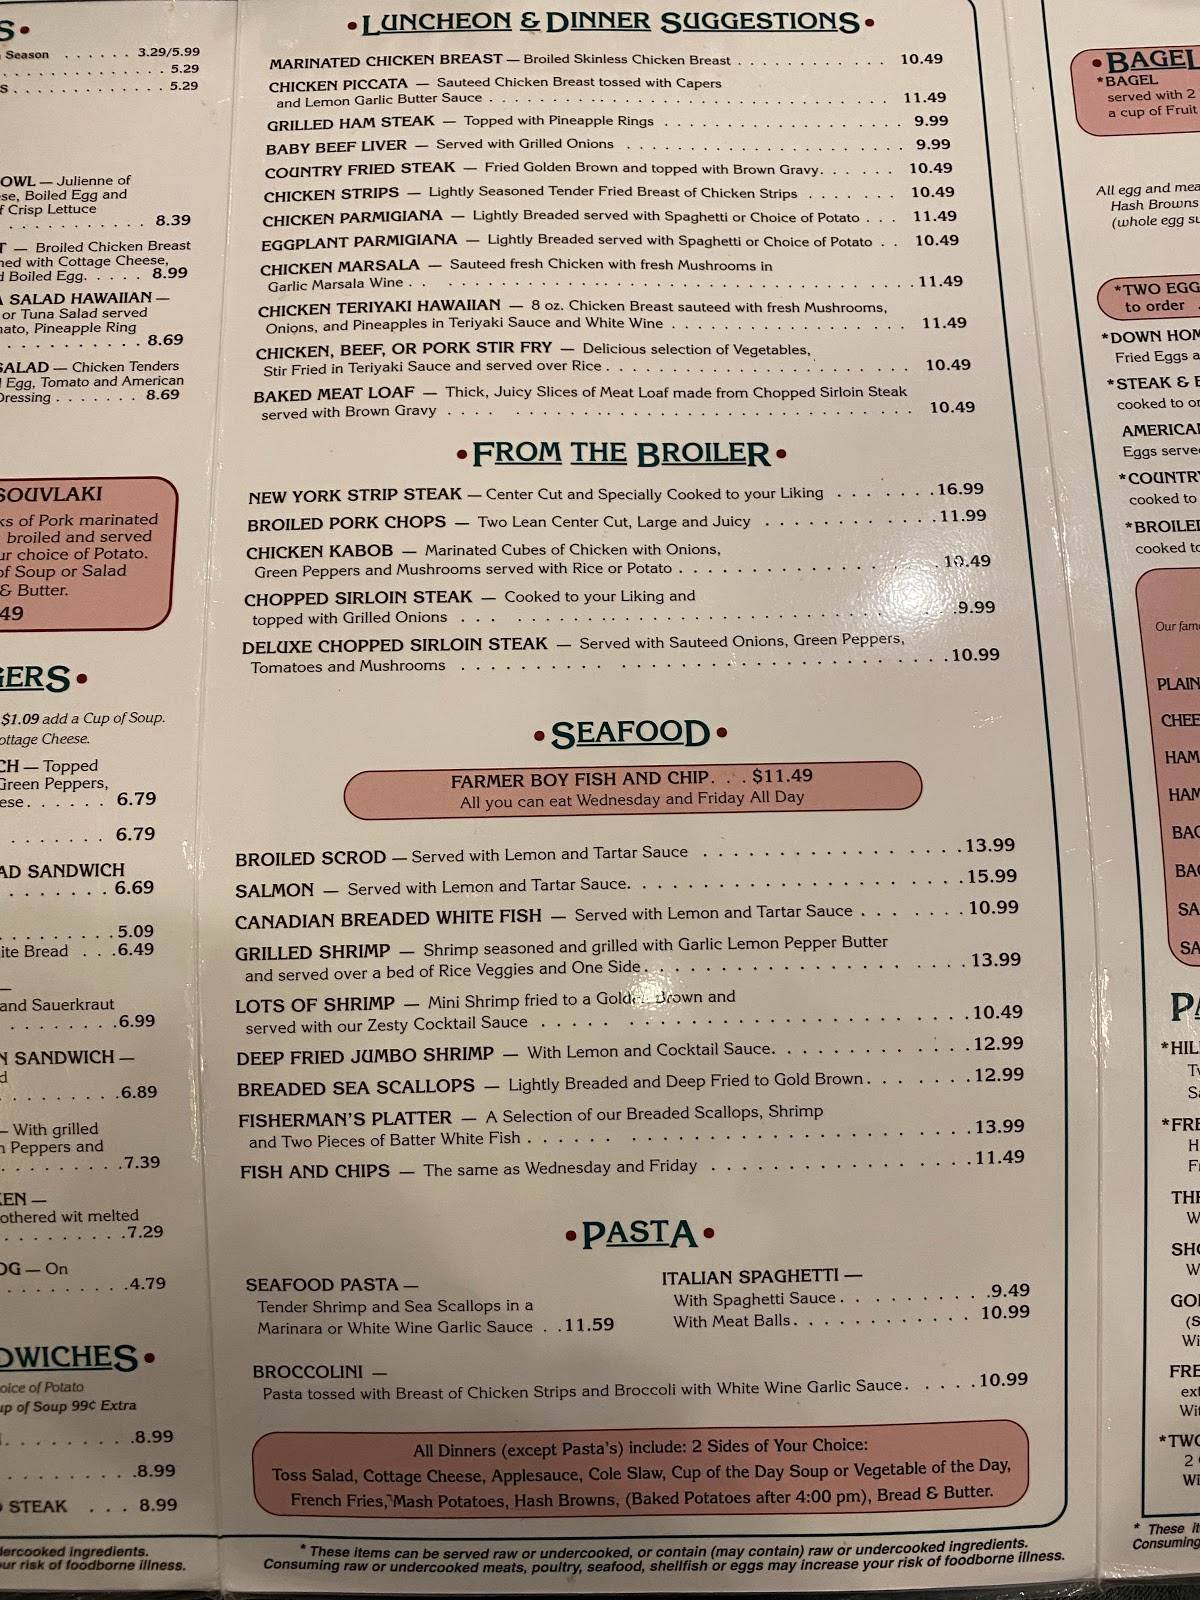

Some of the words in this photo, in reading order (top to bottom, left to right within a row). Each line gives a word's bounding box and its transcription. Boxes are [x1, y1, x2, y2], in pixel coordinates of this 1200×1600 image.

[521, 12, 540, 28] &
[5, 51, 49, 59] Season
[138, 48, 200, 57] 3.29/5.99
[171, 64, 199, 73] 5.29
[270, 57, 360, 70] MARINATED
[366, 55, 434, 66] CHICKEN
[440, 54, 503, 64] BREAST
[524, 54, 569, 63] Broiled
[574, 54, 627, 64] Skinless
[632, 54, 685, 64] Chicken
[690, 55, 731, 65] Breast
[901, 54, 943, 64] 10.49
[269, 81, 338, 93] CHICKEN
[343, 78, 408, 90] PICCATA
[437, 77, 490, 87] Sauteed
[495, 77, 548, 87] Chicken
[553, 77, 595, 86] Breast
[599, 78, 641, 87] tossed
[645, 78, 671, 87] with
[676, 78, 722, 90] Capers
[277, 98, 300, 108] and
[306, 98, 350, 107] Lemon
[355, 95, 393, 105] Garlic
[398, 94, 437, 103] Butter
[442, 93, 482, 102] Sauce
[904, 92, 946, 103] 11.49
[1108, 91, 1151, 102] served
[1156, 90, 1182, 100] with
[1187, 89, 1196, 98] 2
[1121, 110, 1144, 119] cup
[1149, 106, 1162, 116] of
[1166, 105, 1198, 115] Fruit
[267, 119, 333, 131] GRILLED
[340, 117, 375, 129] HAM
[381, 115, 435, 127] STEAK
[464, 116, 513, 128] Topped
[518, 115, 544, 125] with
[550, 115, 613, 127] Pineapple
[618, 116, 654, 128] Rings
[915, 115, 948, 126] 9.99
[1096, 185, 1114, 195] All
[1119, 187, 1141, 197] egg
[1146, 183, 1171, 193] and
[1111, 200, 1144, 211] Hash
[1149, 199, 1198, 209] Browns
[36, 242, 83, 253] Broiled
[88, 241, 143, 252] Chicken
[148, 241, 191, 251] Breast
[26, 257, 53, 267] with
[59, 256, 110, 269] Cottage
[116, 255, 169, 267] Cheese,
[260, 262, 332, 276] CHICKEN
[338, 259, 420, 272] MARSALA
[450, 259, 505, 269] Sauteed
[510, 258, 543, 268] fresh
[548, 258, 603, 269] Chicken
[608, 259, 636, 269] with
[641, 259, 673, 270] fresh
[678, 260, 756, 271] Mushrooms
[761, 261, 772, 271] in
[10, 293, 65, 305] SALAD
[71, 292, 152, 304] HAWAIIAN
[1125, 302, 1141, 312] to
[1146, 300, 1184, 311] order
[262, 408, 307, 420] served
[312, 407, 340, 418] with
[346, 406, 389, 417] Brown
[395, 405, 436, 418] Gravy
[931, 401, 975, 413] 10.49
[249, 491, 287, 504] NEW
[293, 490, 341, 503] YORK
[347, 489, 398, 501] STRIP
[404, 488, 462, 500] STEAK
[486, 488, 533, 500] Center
[538, 488, 563, 499] Cut
[568, 489, 593, 499] and
[598, 488, 662, 503] Specially
[667, 488, 721, 500] Cooked
[726, 490, 739, 499] to
[744, 491, 776, 502] your
[781, 487, 823, 500] Liking
[938, 483, 984, 495] 16.99
[7, 531, 60, 543] broiled
[65, 531, 94, 543] and
[100, 530, 152, 542] served
[452, 774, 525, 788] FARMER
[531, 773, 569, 787] BOY
[575, 772, 616, 786] FISH
[622, 772, 661, 785] AND
[668, 771, 709, 784] CHIP
[753, 768, 812, 784] $11.49
[460, 796, 479, 808] All
[486, 799, 512, 811] you
[518, 799, 544, 807] can
[550, 796, 572, 807] eat
[577, 793, 660, 808] Wednesday
[666, 792, 693, 804] and
[698, 792, 744, 807] Friday
[750, 791, 770, 803] All
[776, 790, 804, 806] Day
[236, 852, 315, 867] BROILED
[322, 850, 386, 865] SCROD
[412, 850, 464, 863] Served
[469, 849, 499, 861] with
[505, 848, 556, 861] Lemon
[562, 847, 588, 859] and
[593, 847, 638, 859] Tartar
[643, 846, 688, 858] Sauce
[966, 838, 1015, 852] 13.99
[28, 863, 125, 878] SANDWICH
[32, 998, 115, 1011] Sauerkraut
[61, 1212, 83, 1222] wit
[88, 1209, 139, 1222] melted
[663, 1271, 732, 1285] ITALIAN
[739, 1268, 839, 1284] SPAGHETTI
[246, 1278, 334, 1291] SEAFOOD
[341, 1278, 399, 1291] PASTA
[257, 1301, 308, 1313] Tender
[313, 1301, 366, 1316] Shrimp
[372, 1300, 399, 1312] and
[405, 1300, 432, 1312] Sea
[438, 1300, 500, 1315] Scallops
[507, 1303, 519, 1311] in
[525, 1302, 533, 1311] a
[101, 1400, 136, 1411] Extra
[413, 1444, 433, 1457] All
[439, 1444, 496, 1457] Dinners
[502, 1443, 557, 1460] (except
[562, 1441, 623, 1458] Pasta's)
[629, 1440, 686, 1454] include:
[692, 1440, 702, 1453] 2
[708, 1439, 749, 1452] Sides
[755, 1439, 769, 1452] of
[773, 1439, 808, 1452] Your
[813, 1438, 868, 1451] Choice:
[139, 1560, 187, 1571] illness.
[531, 1561, 585, 1575] poultry,
[587, 1560, 646, 1574] seafood,
[650, 1560, 708, 1571] shellfish
